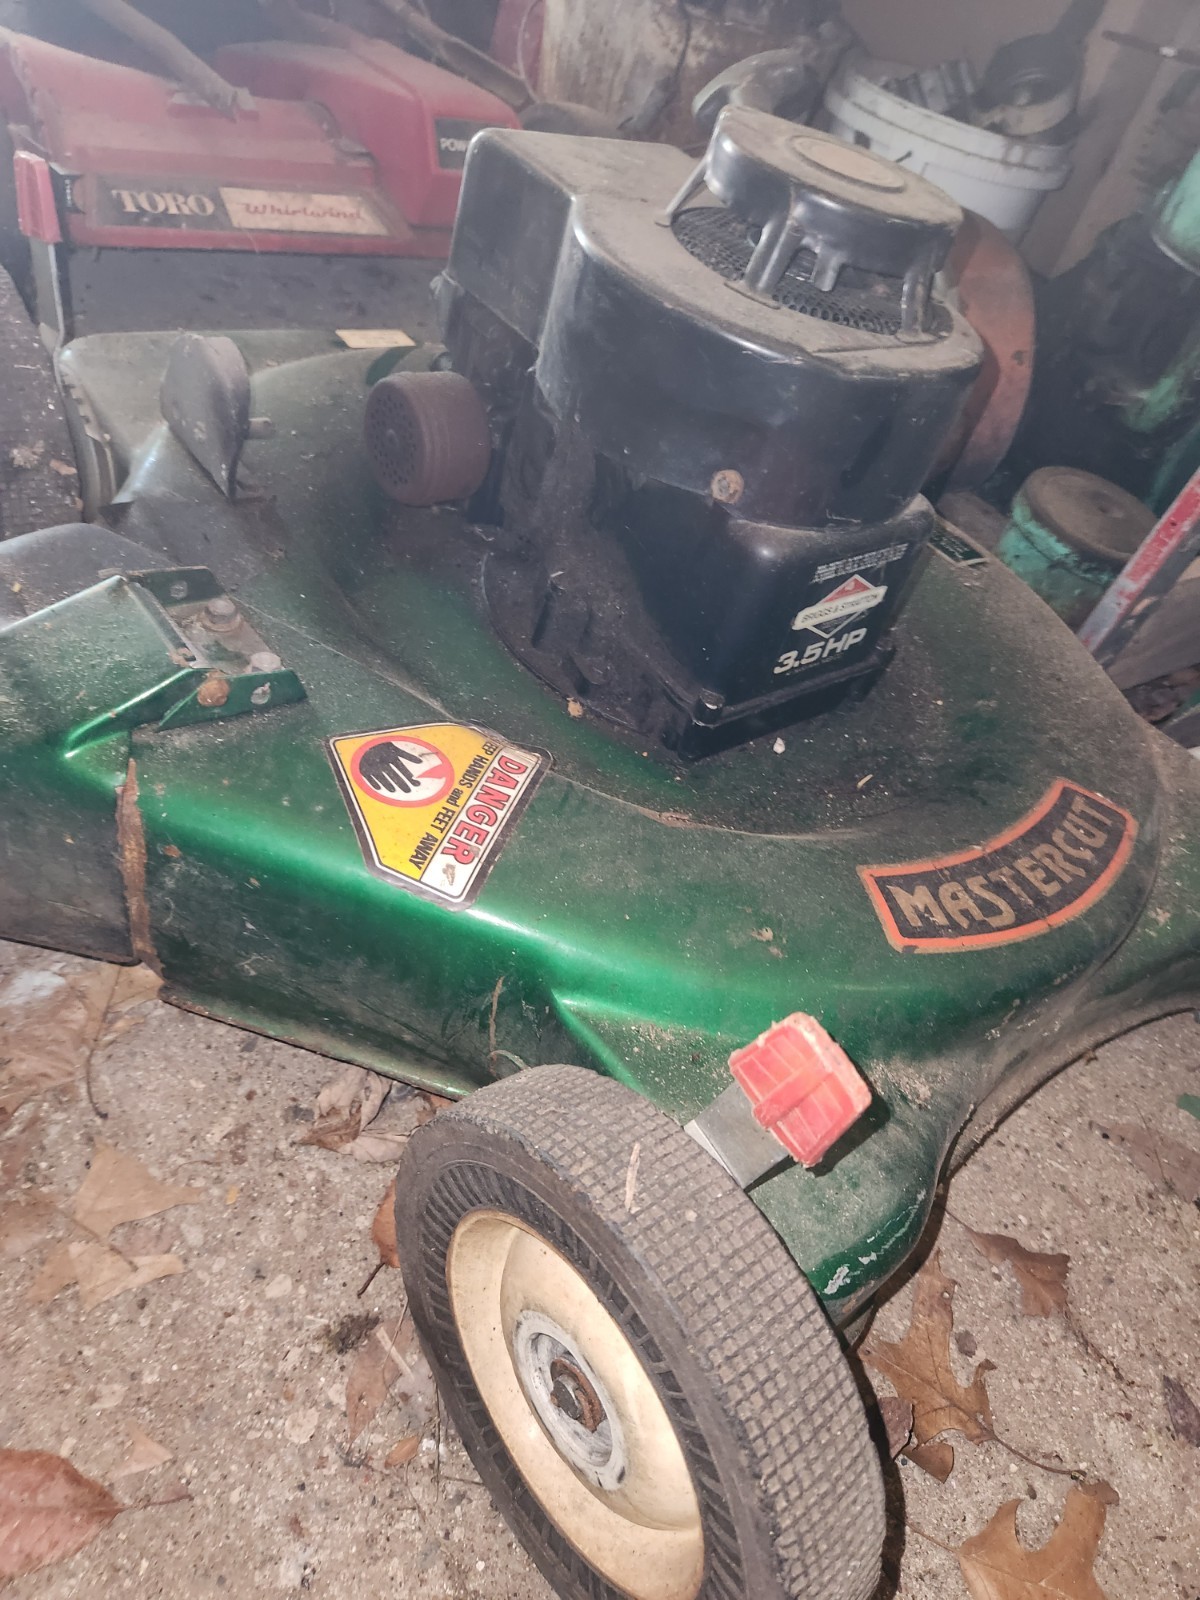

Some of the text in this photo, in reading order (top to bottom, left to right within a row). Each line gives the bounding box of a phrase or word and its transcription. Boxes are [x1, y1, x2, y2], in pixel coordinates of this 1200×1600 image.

[440, 138, 470, 152] POW
[111, 189, 215, 216] TORO
[237, 203, 367, 221] Whirlwind
[773, 627, 867, 674] 3.5HP
[408, 741, 499, 870] EEP HANDS and FEET AWAY
[441, 755, 528, 865] DANGER
[886, 795, 1112, 929] MASTERCUT
